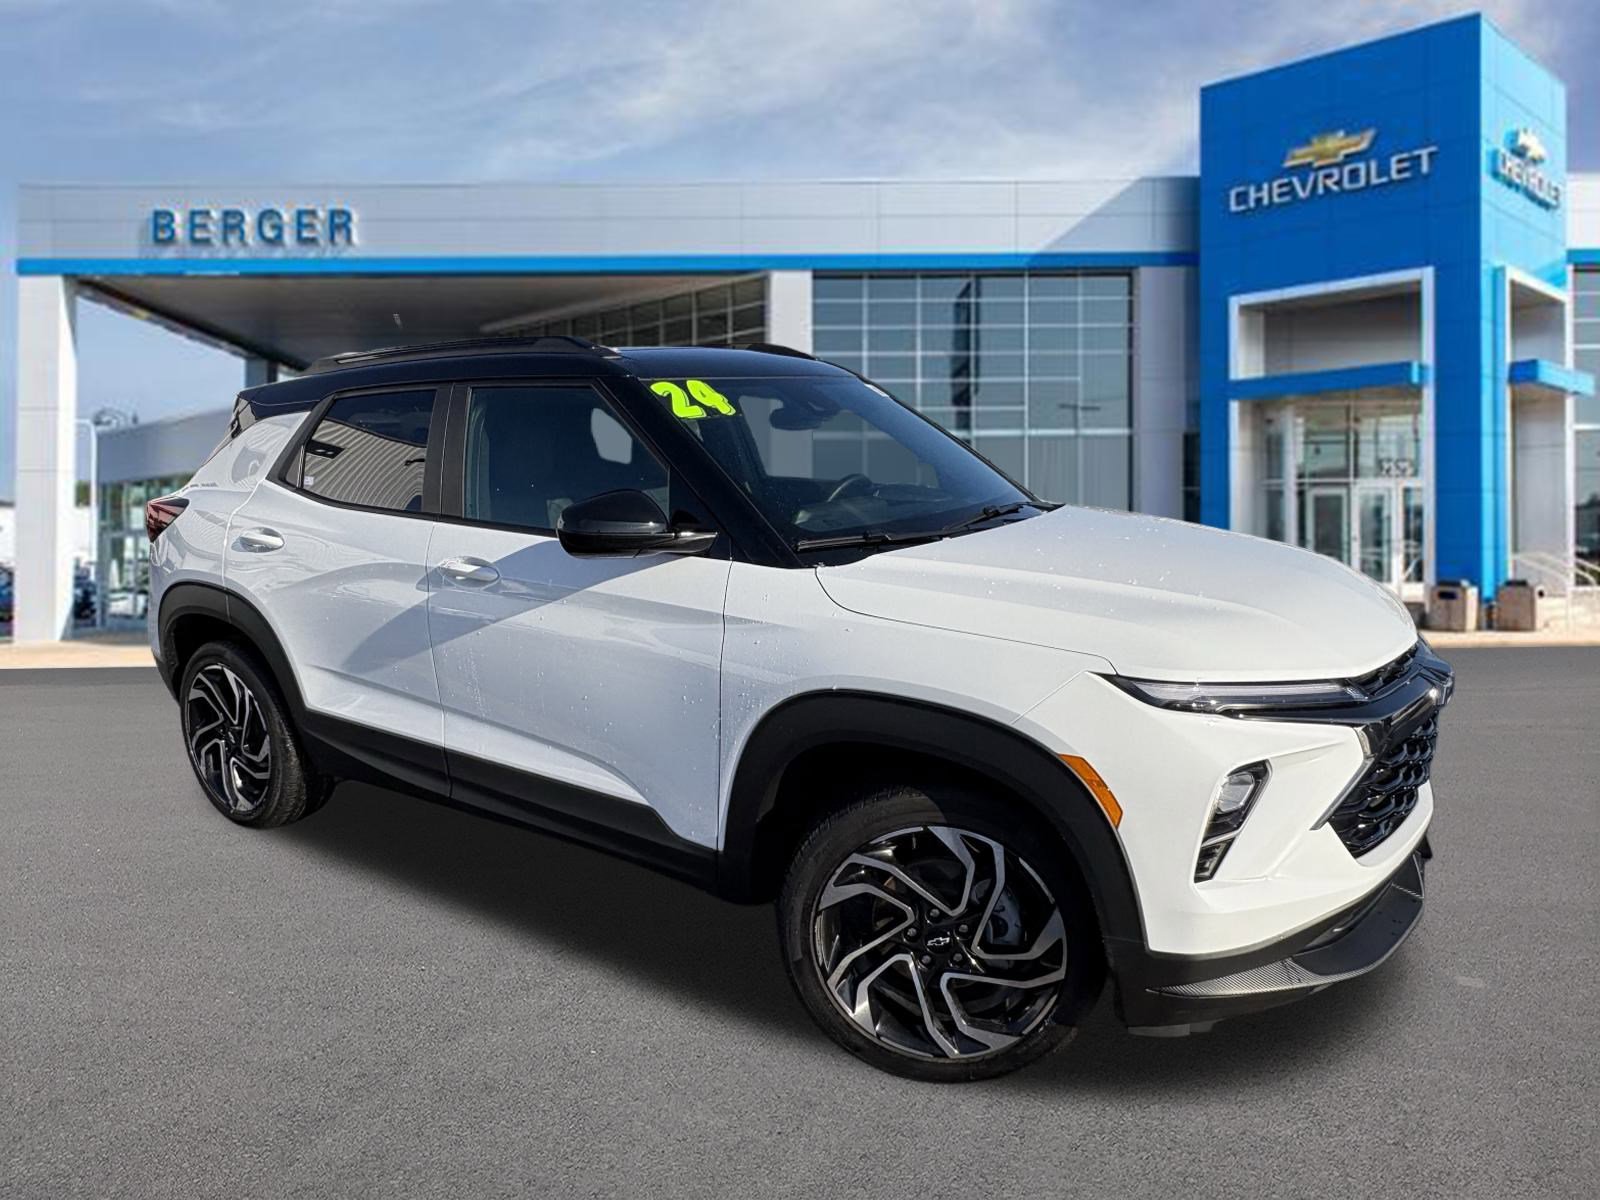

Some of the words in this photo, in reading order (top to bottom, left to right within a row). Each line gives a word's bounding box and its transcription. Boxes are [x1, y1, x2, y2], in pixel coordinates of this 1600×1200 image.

[1229, 146, 1438, 212] CHEVROLET
[152, 209, 355, 244] BERGER
[650, 380, 736, 418] 24
